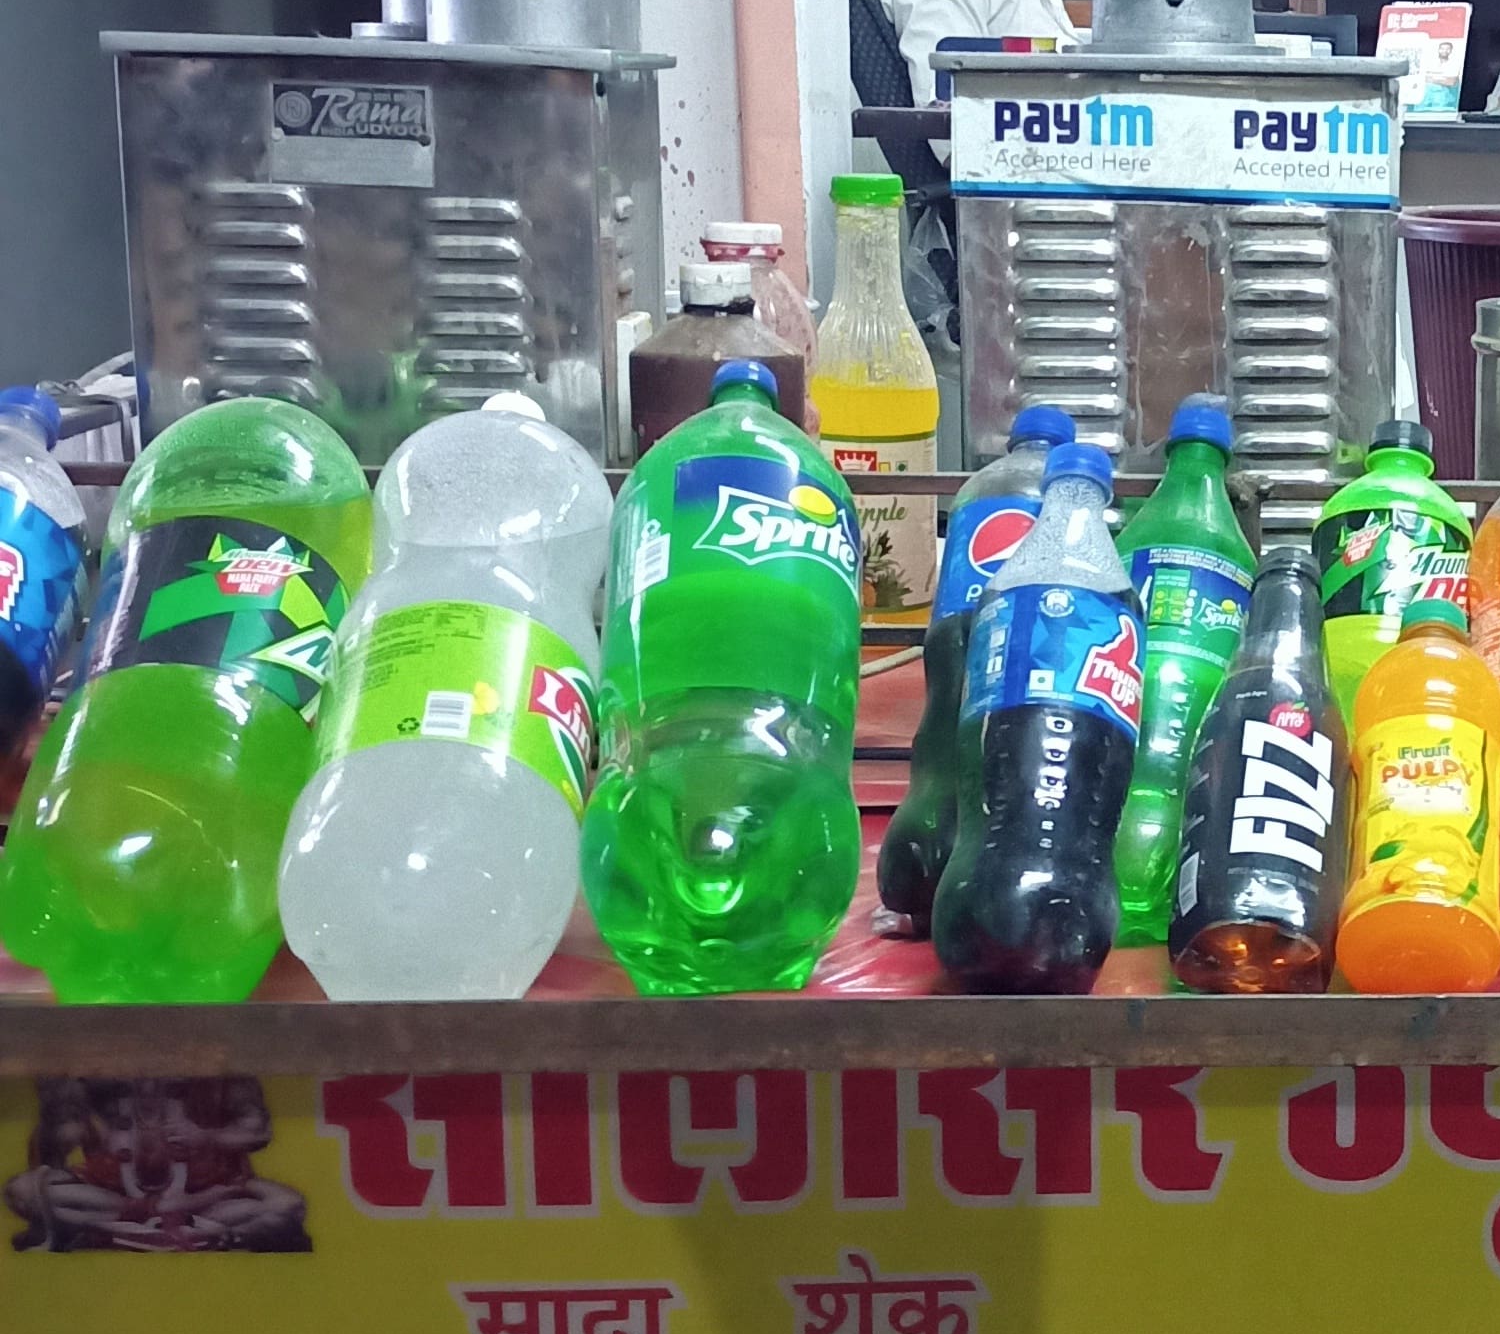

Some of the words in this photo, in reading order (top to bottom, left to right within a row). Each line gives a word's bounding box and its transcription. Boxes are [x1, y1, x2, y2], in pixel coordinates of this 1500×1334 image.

[311, 88, 423, 134] Rama
[994, 148, 1093, 173] Accepted
[1101, 150, 1152, 173] Here
[1234, 156, 1330, 180] Accepted
[1338, 160, 1387, 181] Here
[719, 501, 858, 574] Sprite
[1229, 718, 1335, 873] FIZZ
[1381, 758, 1475, 787] PULPY
